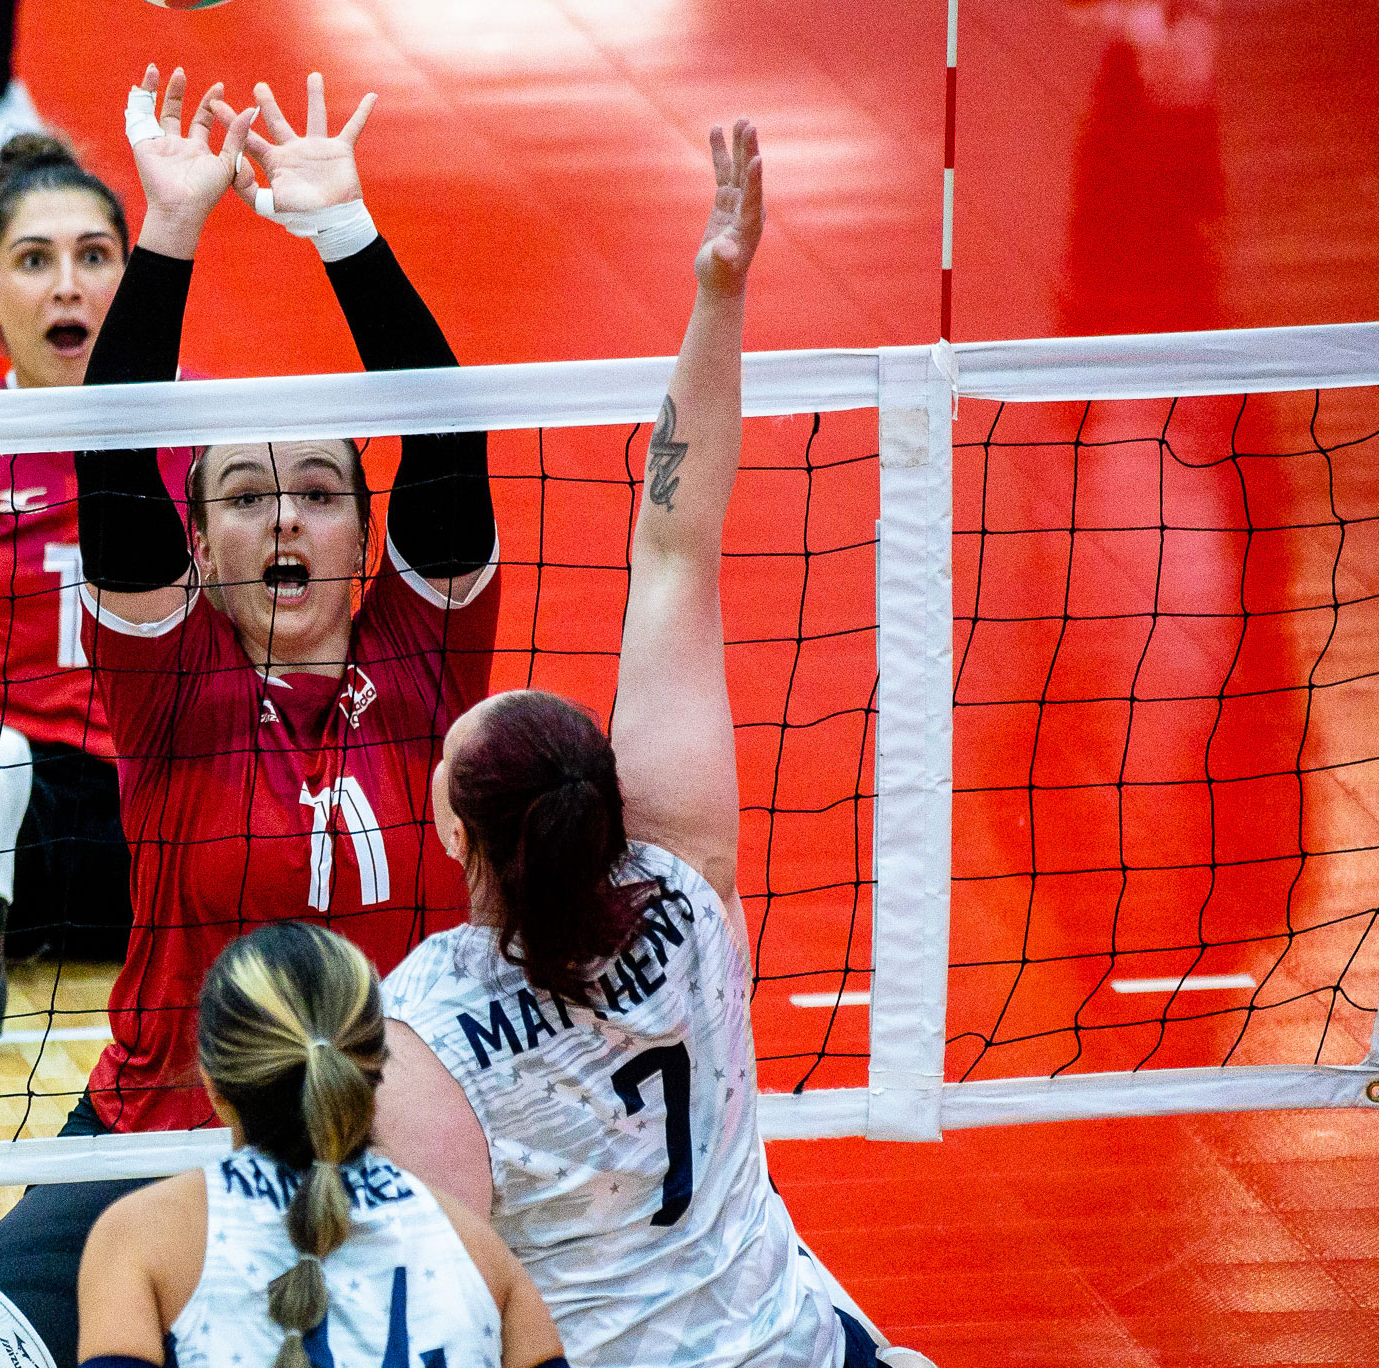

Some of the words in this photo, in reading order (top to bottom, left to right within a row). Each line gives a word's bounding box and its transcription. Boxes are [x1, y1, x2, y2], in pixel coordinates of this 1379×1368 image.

[299, 776, 390, 912] 11
[457, 875, 695, 1069] MATHEWS
[611, 1041, 693, 1227] 7
